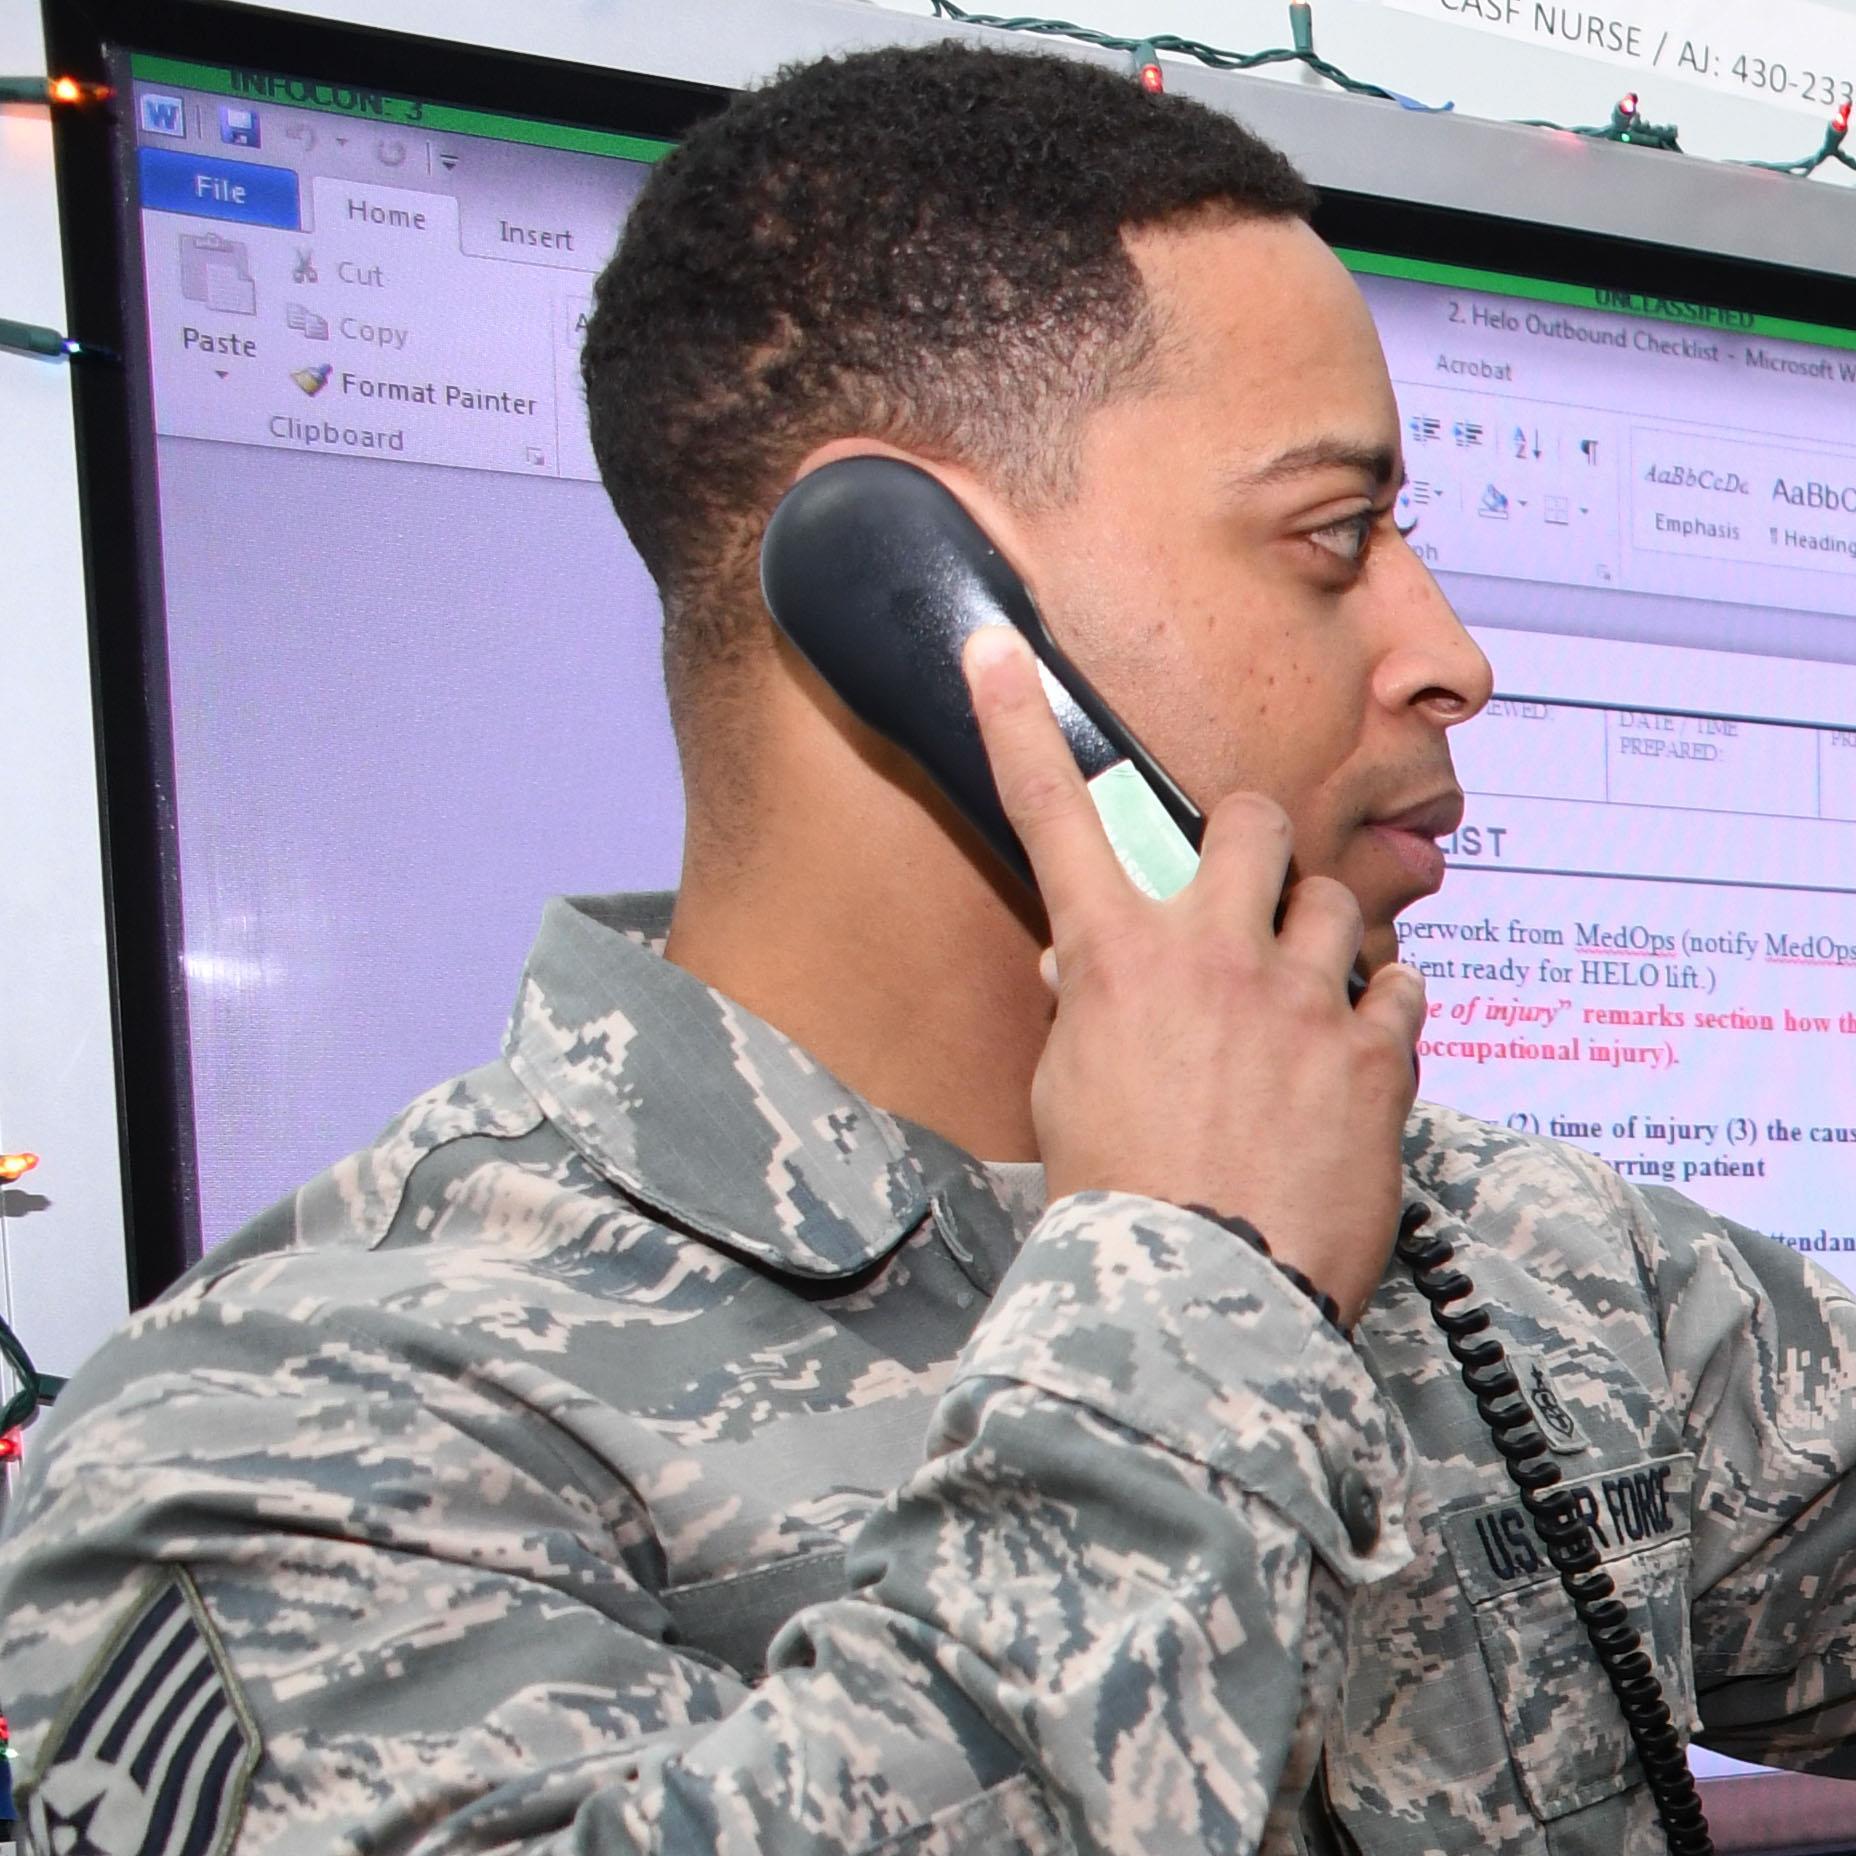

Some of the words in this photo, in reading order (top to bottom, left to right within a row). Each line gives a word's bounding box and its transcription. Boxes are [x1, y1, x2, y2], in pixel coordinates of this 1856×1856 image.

[1533, 2, 1641, 58] NURSE
[1653, 31, 1668, 66] /
[1678, 40, 1719, 78] AJ:
[194, 175, 246, 204] File
[348, 198, 426, 231] Home
[499, 220, 575, 252] Insert
[338, 261, 386, 288] Cut
[183, 327, 256, 359] Paste
[340, 317, 409, 351] Copy
[1472, 305, 1519, 333] Helo
[1525, 314, 1627, 348] Outbound
[1634, 330, 1719, 362] Checklist
[1745, 349, 1834, 381] Microsoft
[1436, 353, 1513, 383] Acrobat
[342, 373, 436, 405] Format
[446, 385, 538, 416] Painter
[269, 415, 404, 452] Clipboard
[1655, 513, 1741, 541] Emphasis
[1508, 920, 1563, 945] from
[1575, 922, 1676, 955] MedOps
[1682, 928, 1758, 957] (notify
[1461, 959, 1529, 986] ready
[1538, 959, 1572, 983] for
[1581, 960, 1659, 988] HELO
[1583, 1002, 1685, 1027] remarks
[1695, 1006, 1774, 1031] section
[1783, 1009, 1830, 1033] how
[1588, 1039, 1680, 1069] injury).
[1550, 1115, 1602, 1138] time
[1613, 1117, 1637, 1139] of
[1645, 1117, 1718, 1145] injury
[1727, 1118, 1757, 1145] (3)
[1767, 1120, 1802, 1143] the
[1683, 1154, 1766, 1183] patient
